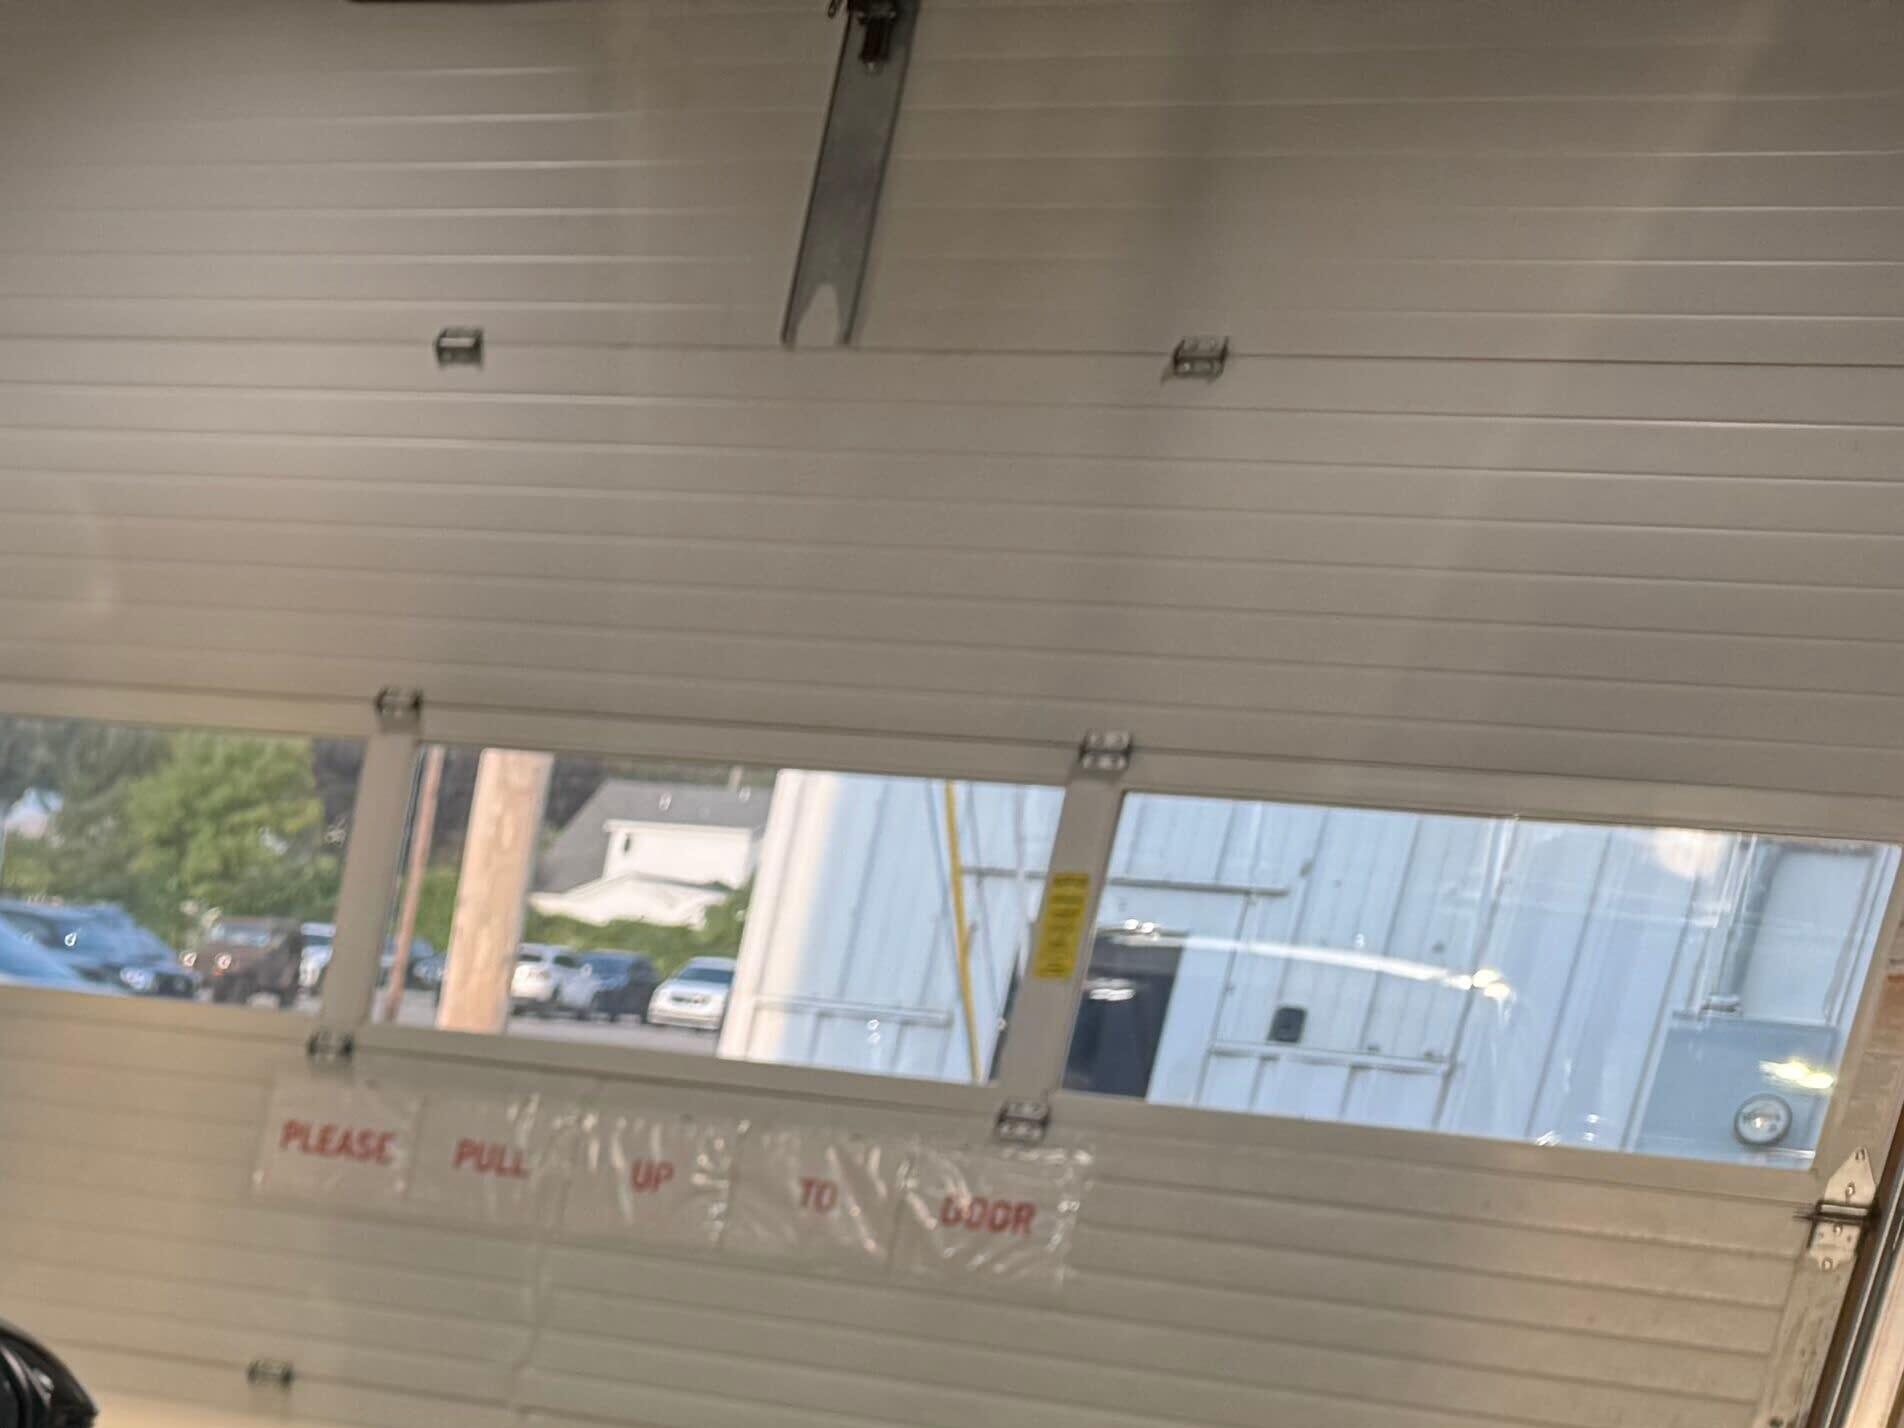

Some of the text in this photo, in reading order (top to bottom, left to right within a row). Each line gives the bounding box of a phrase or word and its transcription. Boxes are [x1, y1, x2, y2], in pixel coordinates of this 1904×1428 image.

[280, 1119, 1038, 1235] PLEASE PULL UP TO DOOR
